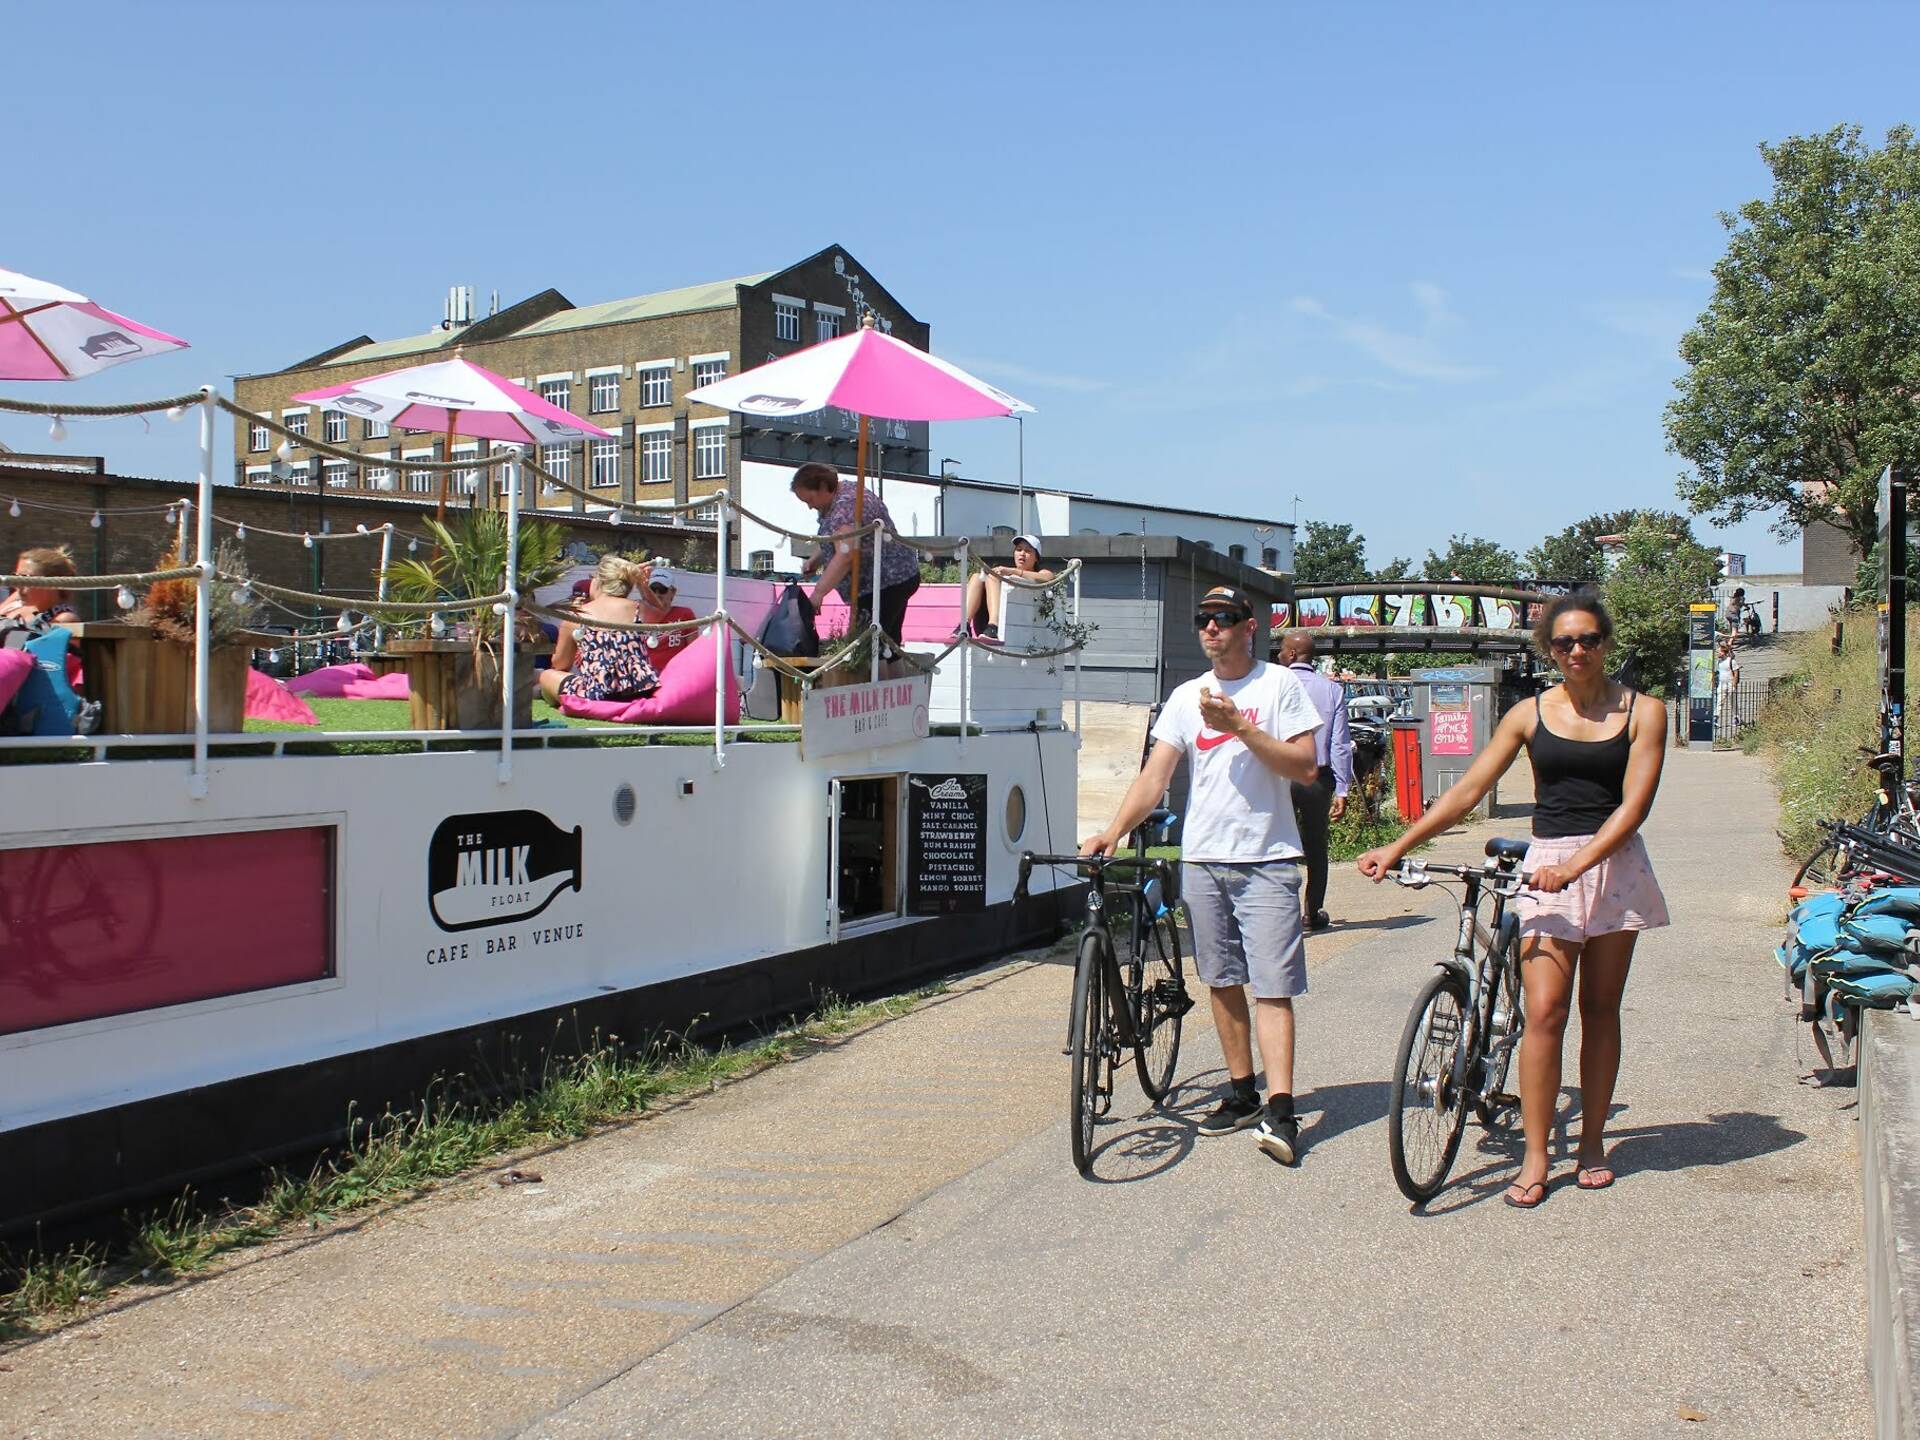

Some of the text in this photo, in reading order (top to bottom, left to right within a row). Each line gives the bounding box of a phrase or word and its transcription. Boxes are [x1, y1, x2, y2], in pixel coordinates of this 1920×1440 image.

[668, 634, 681, 647] 85
[824, 683, 913, 719] THE MILK FLOAT
[942, 778, 961, 791] Ice
[931, 785, 966, 799] Creams
[930, 801, 969, 809] VANILLA
[922, 812, 975, 820] MINT CHOC
[457, 833, 483, 846] THE
[920, 832, 976, 840] STRAWBERRY
[922, 852, 974, 860] CHOCOLATE
[455, 844, 531, 888] MILK
[928, 864, 975, 872] PISTACHIO
[952, 874, 983, 882] SORBET
[920, 884, 984, 892] MANGO SORBET
[490, 891, 531, 907] FLOAT
[426, 923, 584, 965] CAFE BAR VENUE
